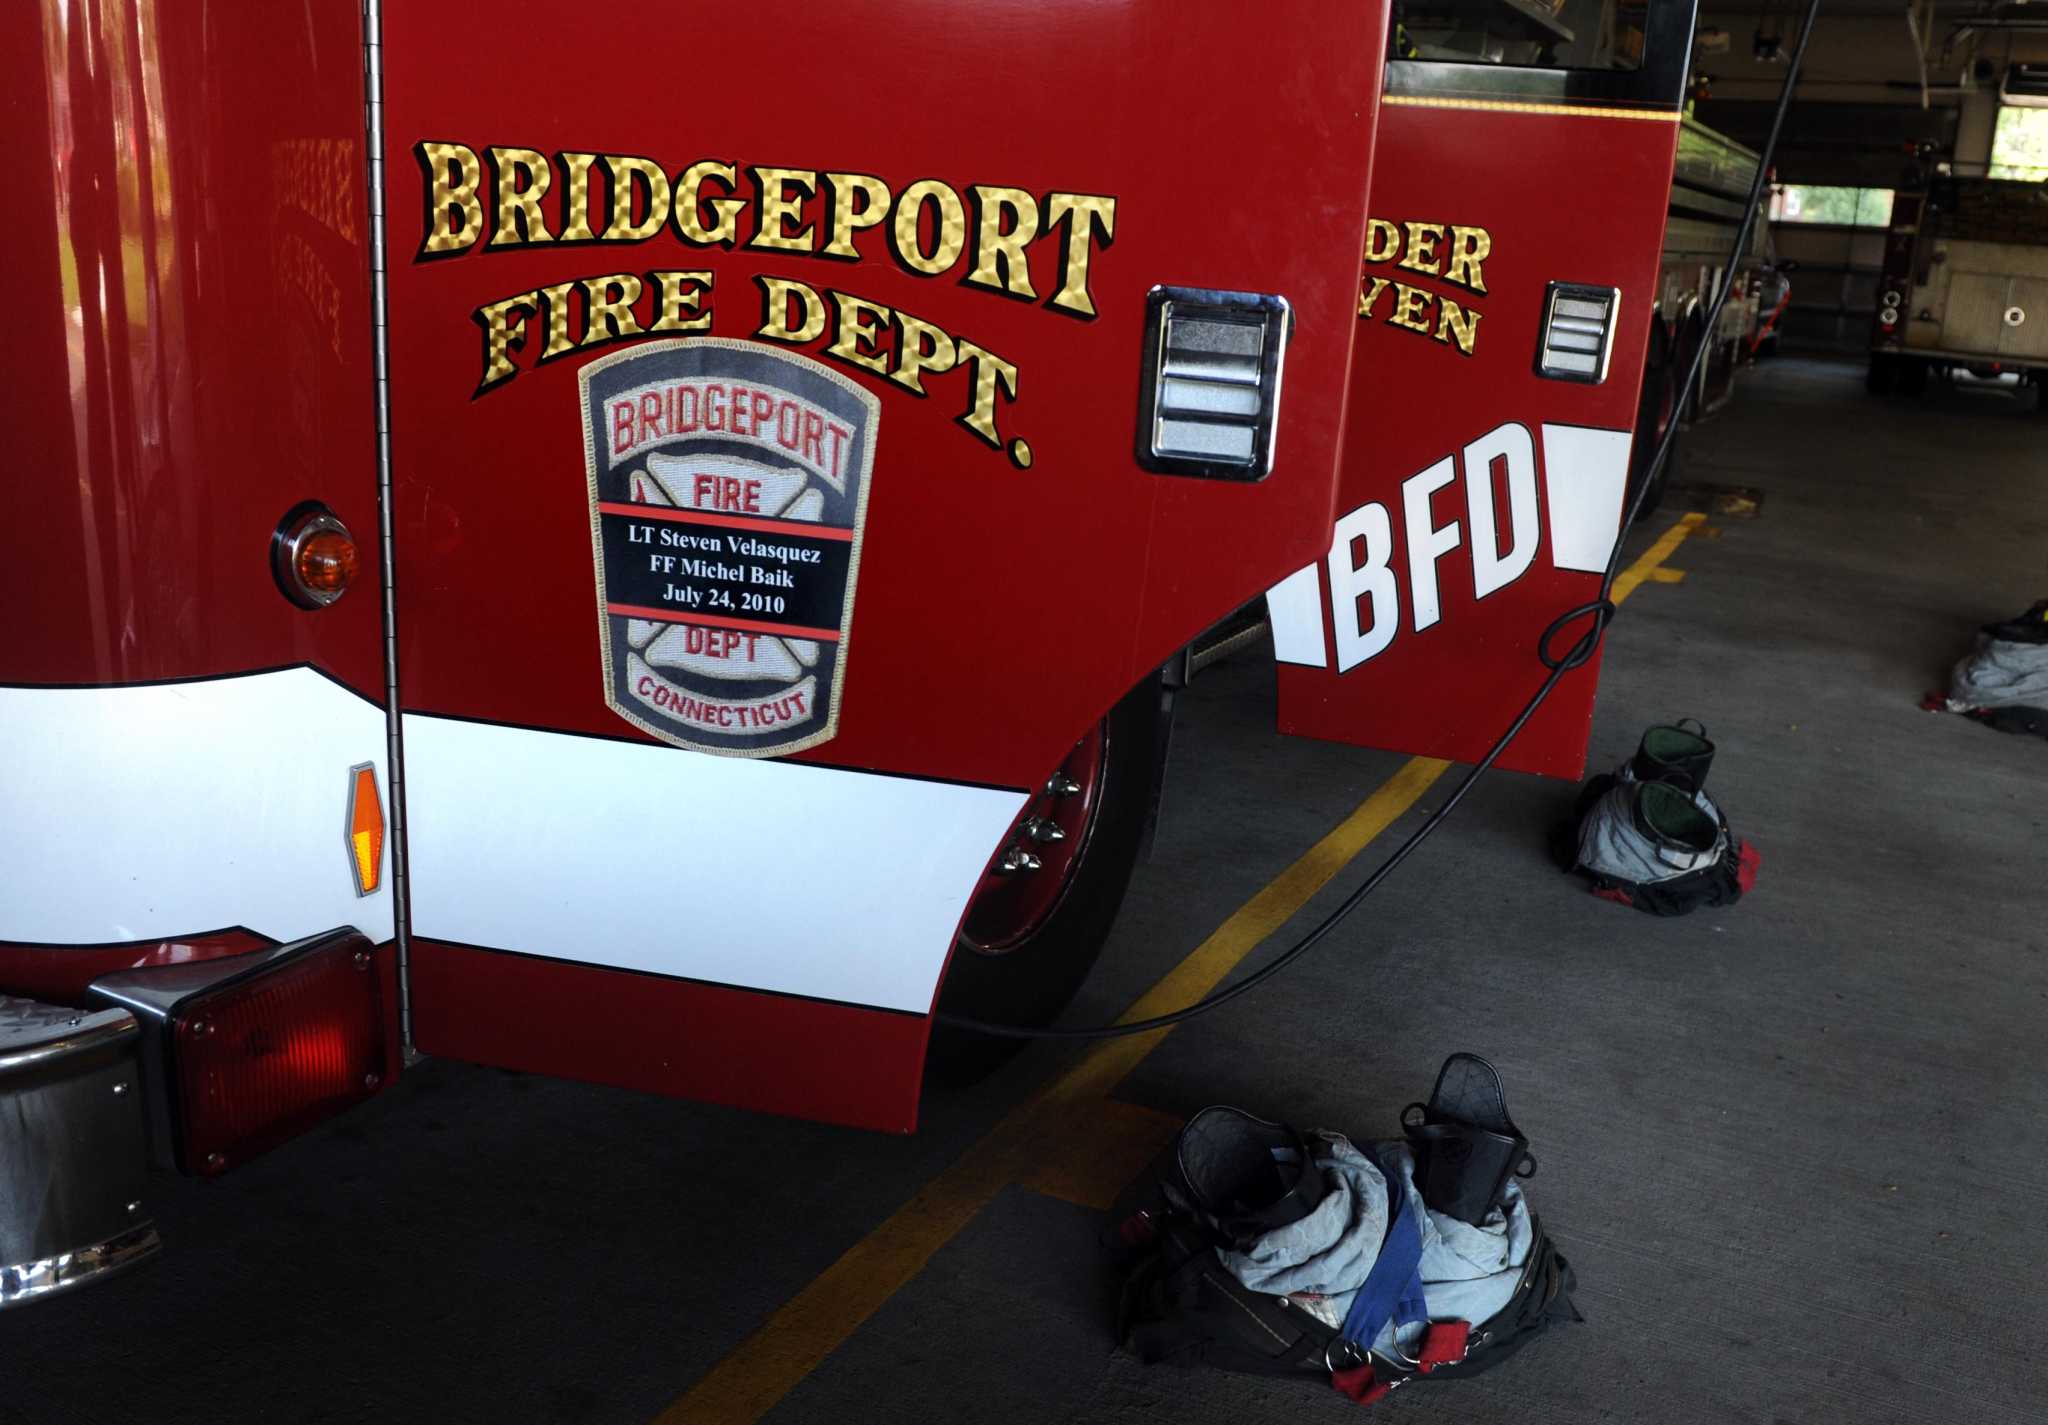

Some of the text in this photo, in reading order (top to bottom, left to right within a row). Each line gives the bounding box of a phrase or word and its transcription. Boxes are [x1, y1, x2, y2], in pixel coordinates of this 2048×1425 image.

[415, 141, 1117, 319] BRIDGEPORT
[1364, 218, 1492, 293] DER
[473, 270, 714, 397] FIRE
[751, 273, 1034, 469] DEPT.
[612, 383, 848, 478] BRIDGEPORT
[692, 473, 761, 513] FIRE
[629, 524, 821, 564] LT Steven Velasquez
[1327, 421, 1542, 675] BFD
[649, 554, 795, 588] FF Michel Baik
[663, 583, 785, 614] July 24, 2010
[684, 626, 761, 662] DEPT
[637, 676, 808, 727] CONNECTICUT
